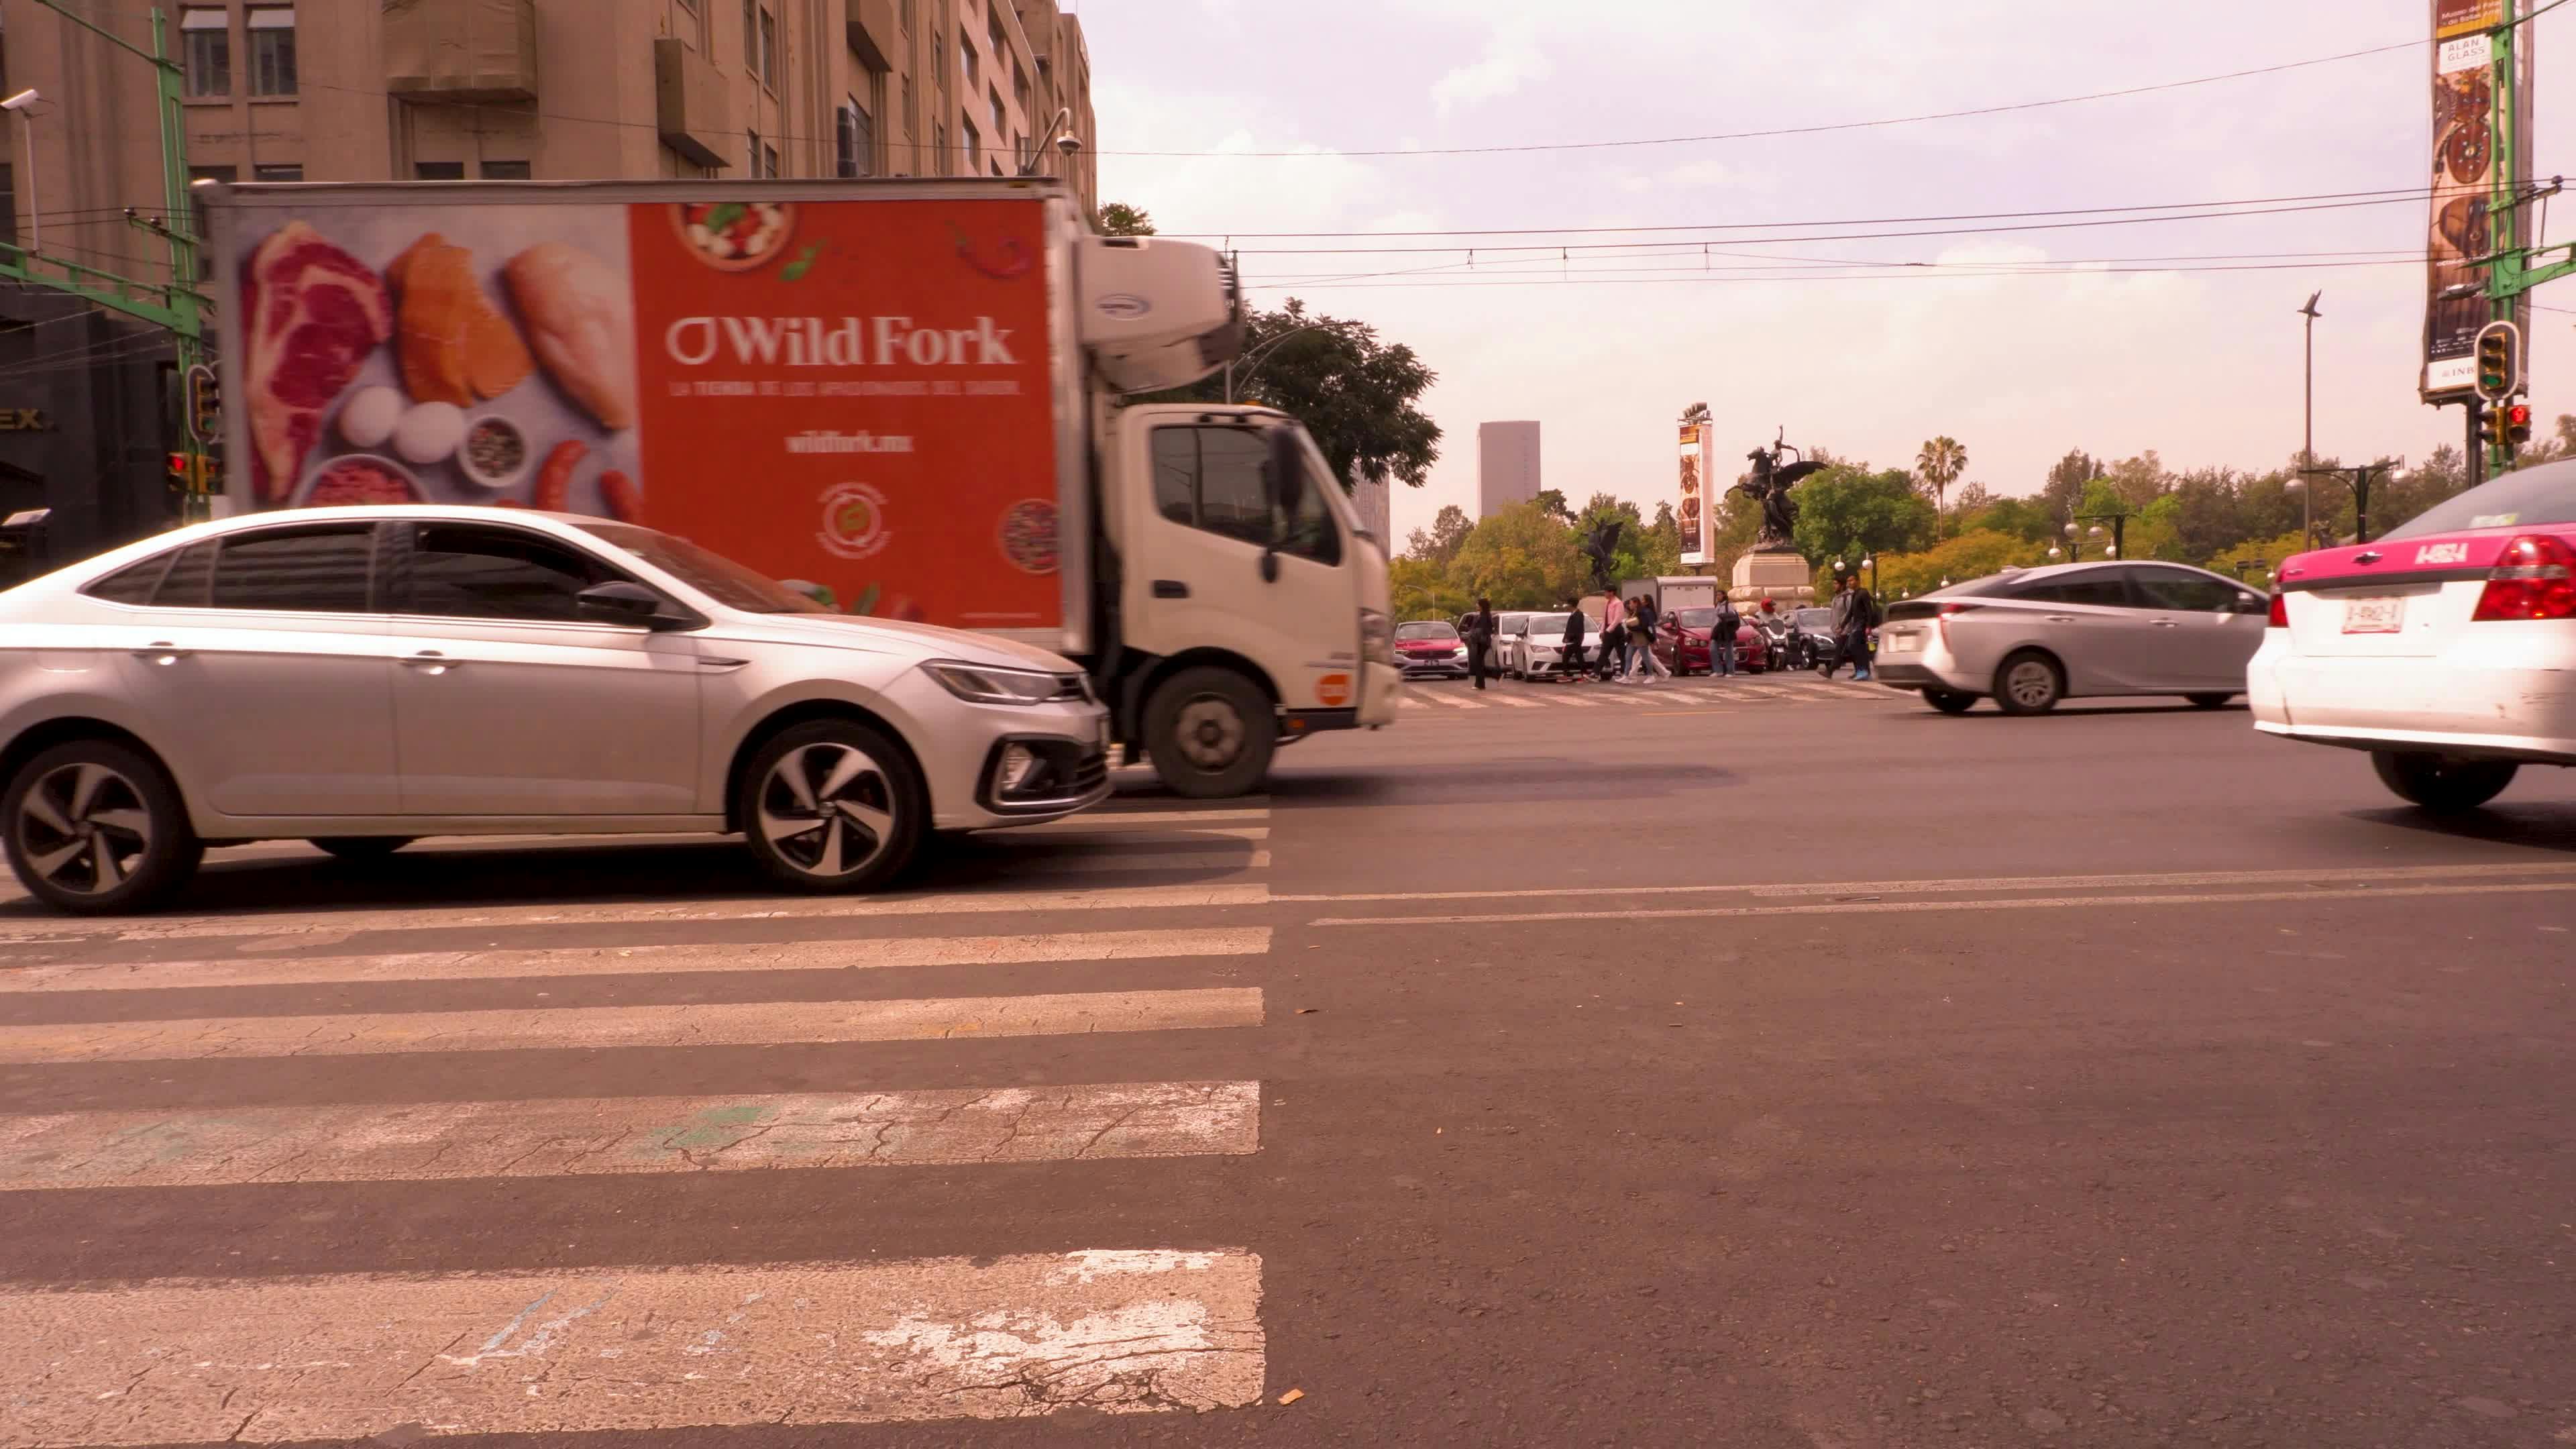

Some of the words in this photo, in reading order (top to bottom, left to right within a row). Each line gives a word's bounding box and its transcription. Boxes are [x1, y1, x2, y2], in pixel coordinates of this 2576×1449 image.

[2449, 38, 2479, 52] ALAN
[2448, 47, 2485, 61] GLASS
[719, 316, 865, 366] Wild
[870, 316, 1021, 365] Fork
